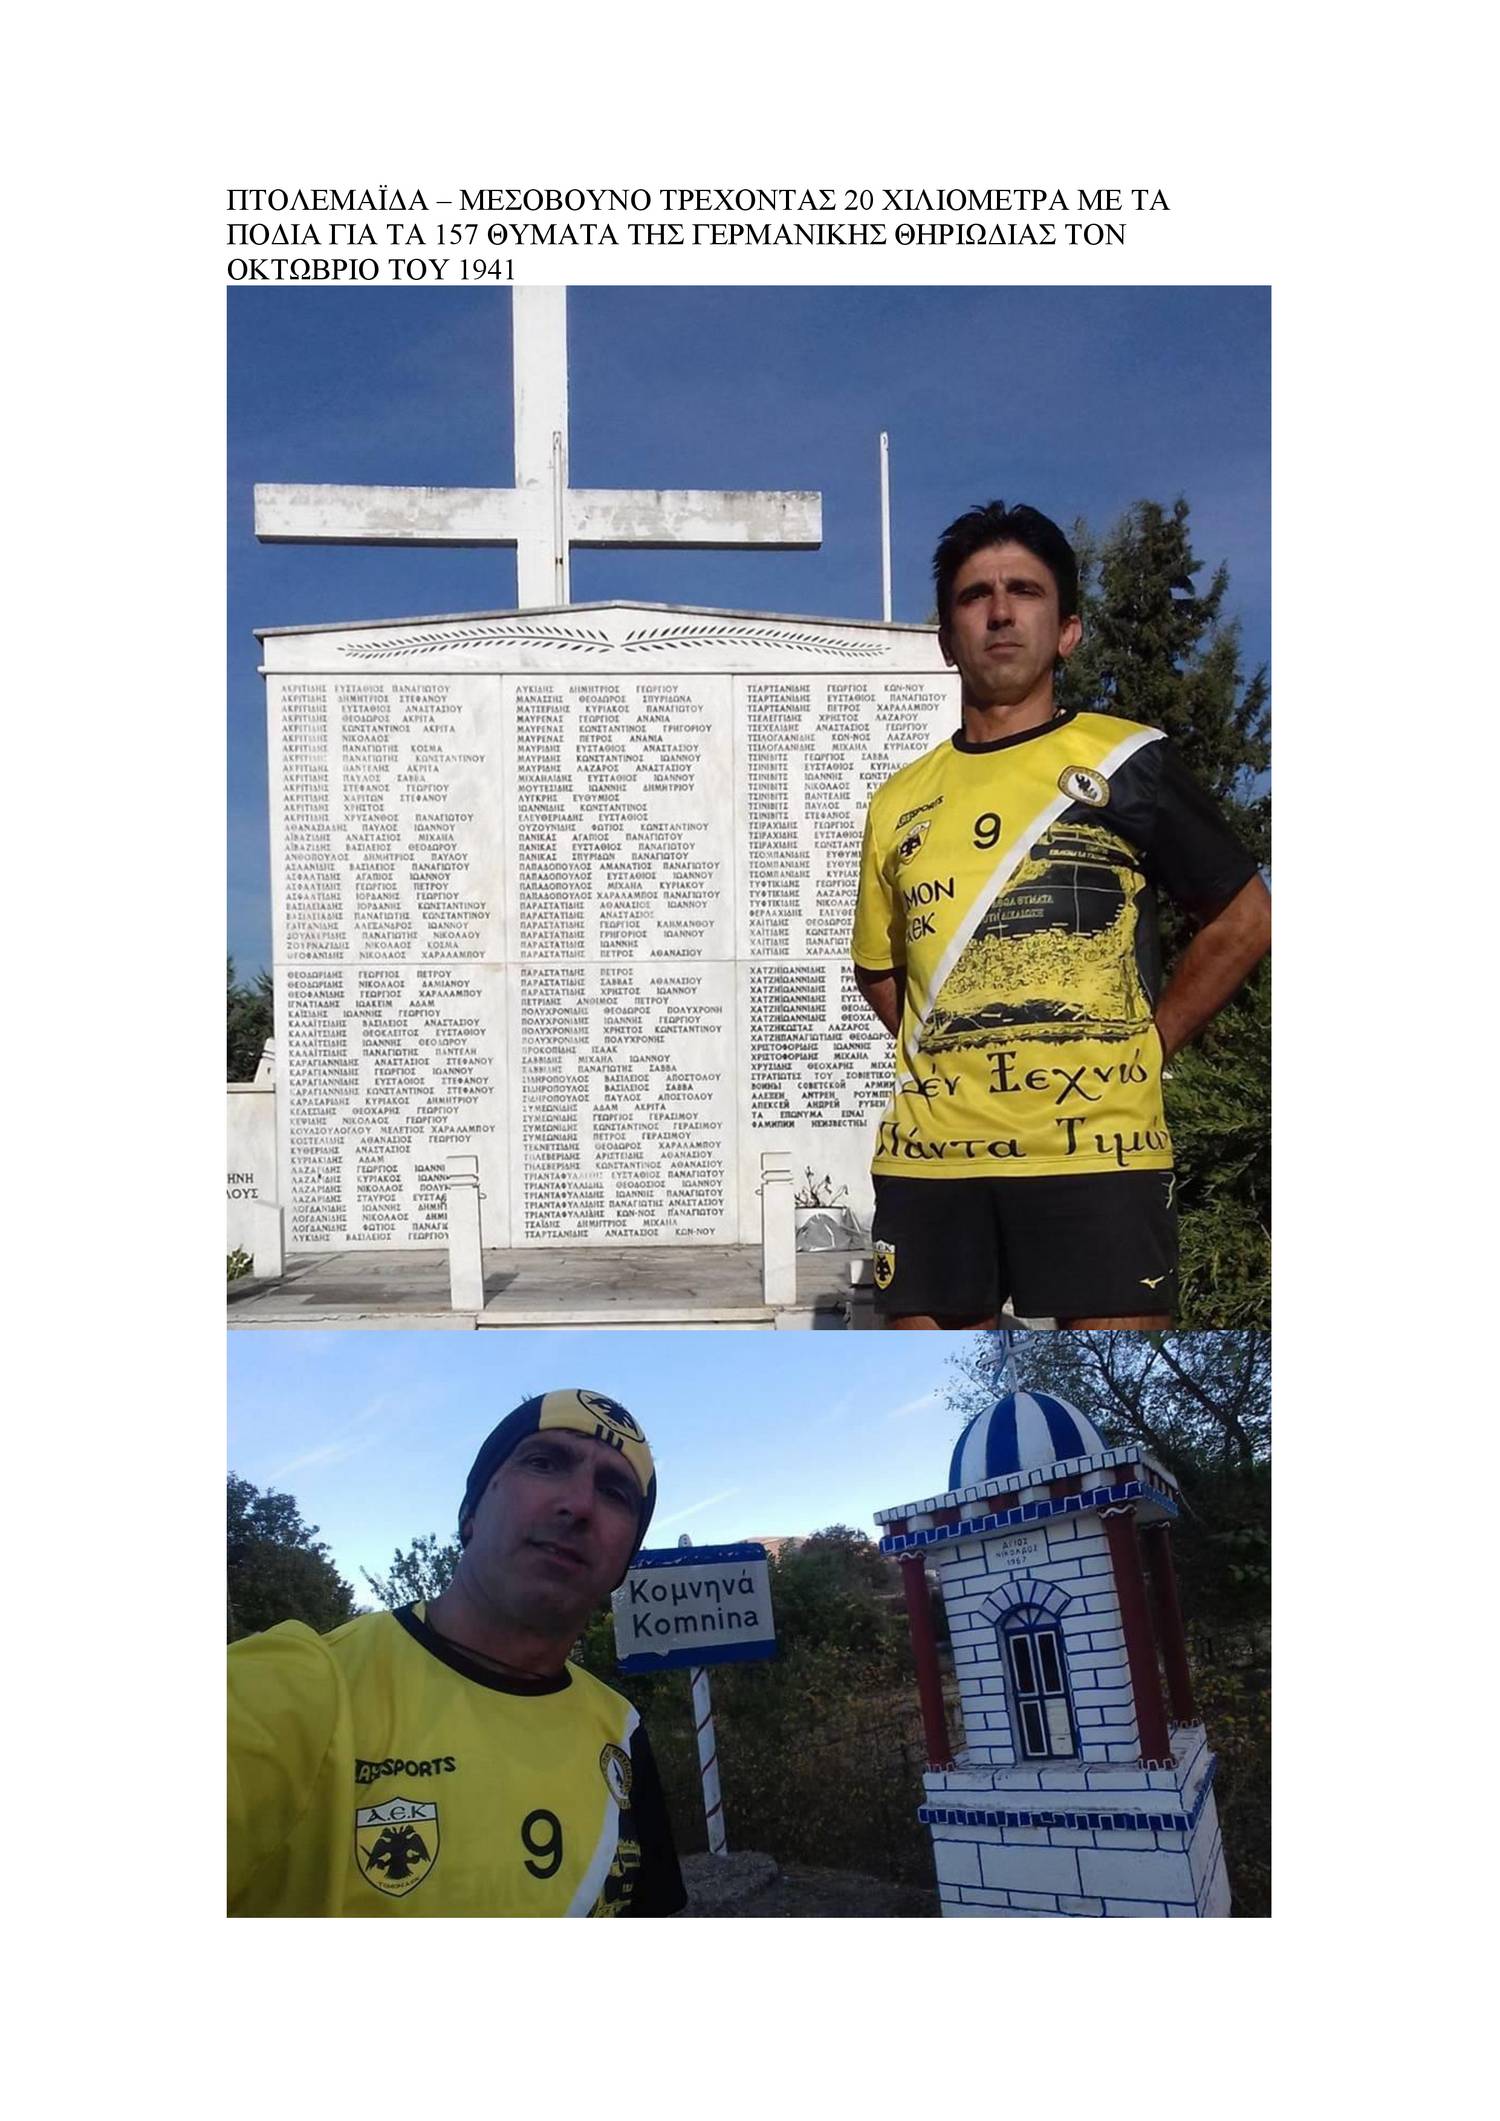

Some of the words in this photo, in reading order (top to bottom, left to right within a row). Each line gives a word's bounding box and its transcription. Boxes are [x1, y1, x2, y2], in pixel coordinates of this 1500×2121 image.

[973, 812, 1002, 850] 9
[629, 1569, 755, 1604] Κομνηνά
[633, 1607, 760, 1639] Komnina
[521, 1808, 563, 1880] 9
